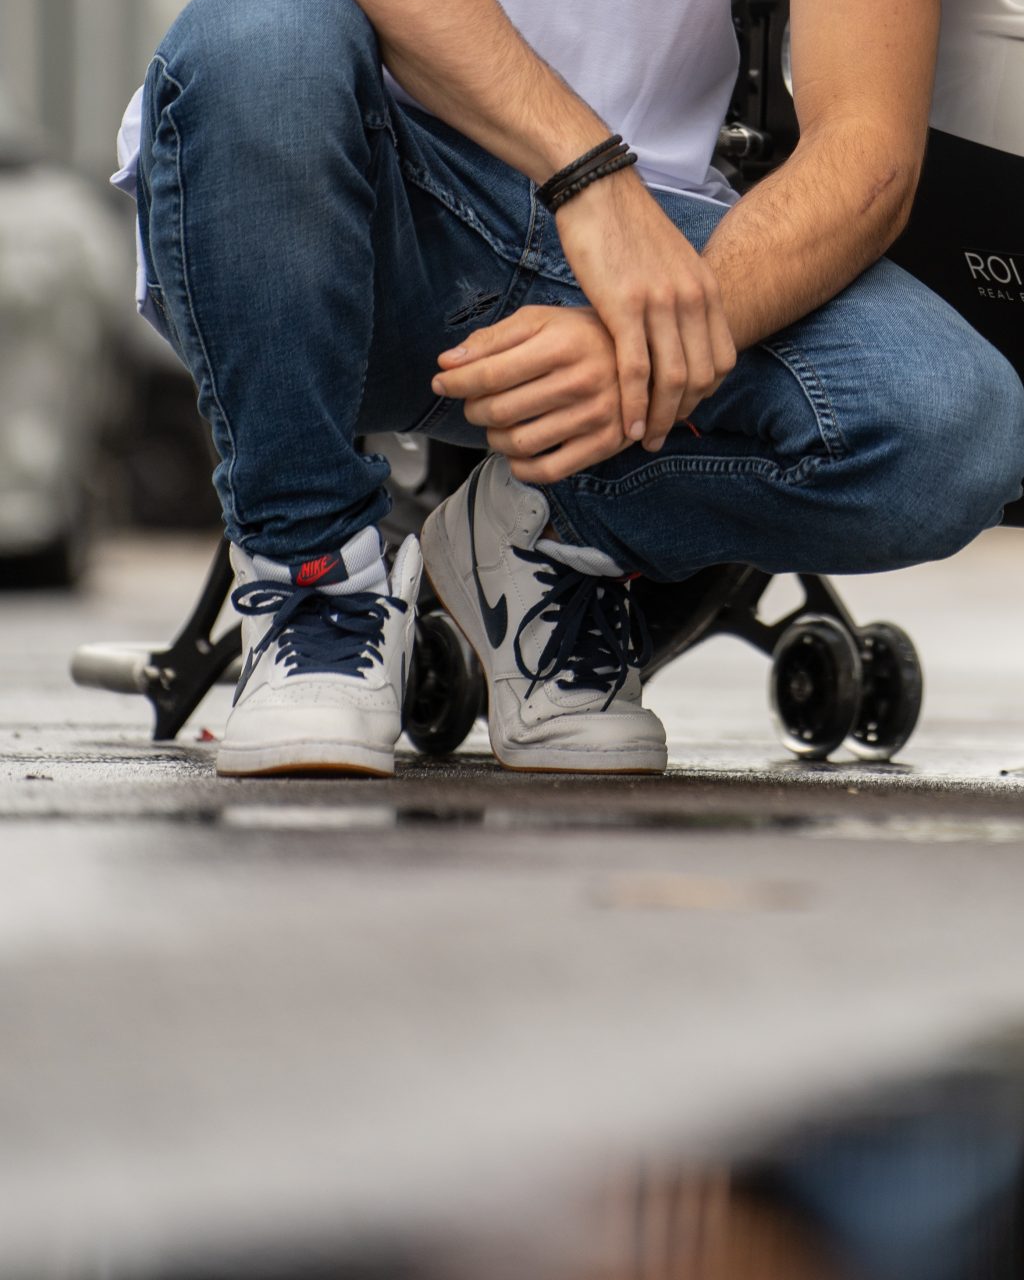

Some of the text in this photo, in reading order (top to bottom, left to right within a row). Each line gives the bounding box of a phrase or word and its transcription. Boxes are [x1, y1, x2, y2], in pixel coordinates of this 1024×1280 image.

[964, 252, 1022, 285] ROI
[978, 287, 1014, 301] REAL
[301, 556, 328, 578] NIKE
